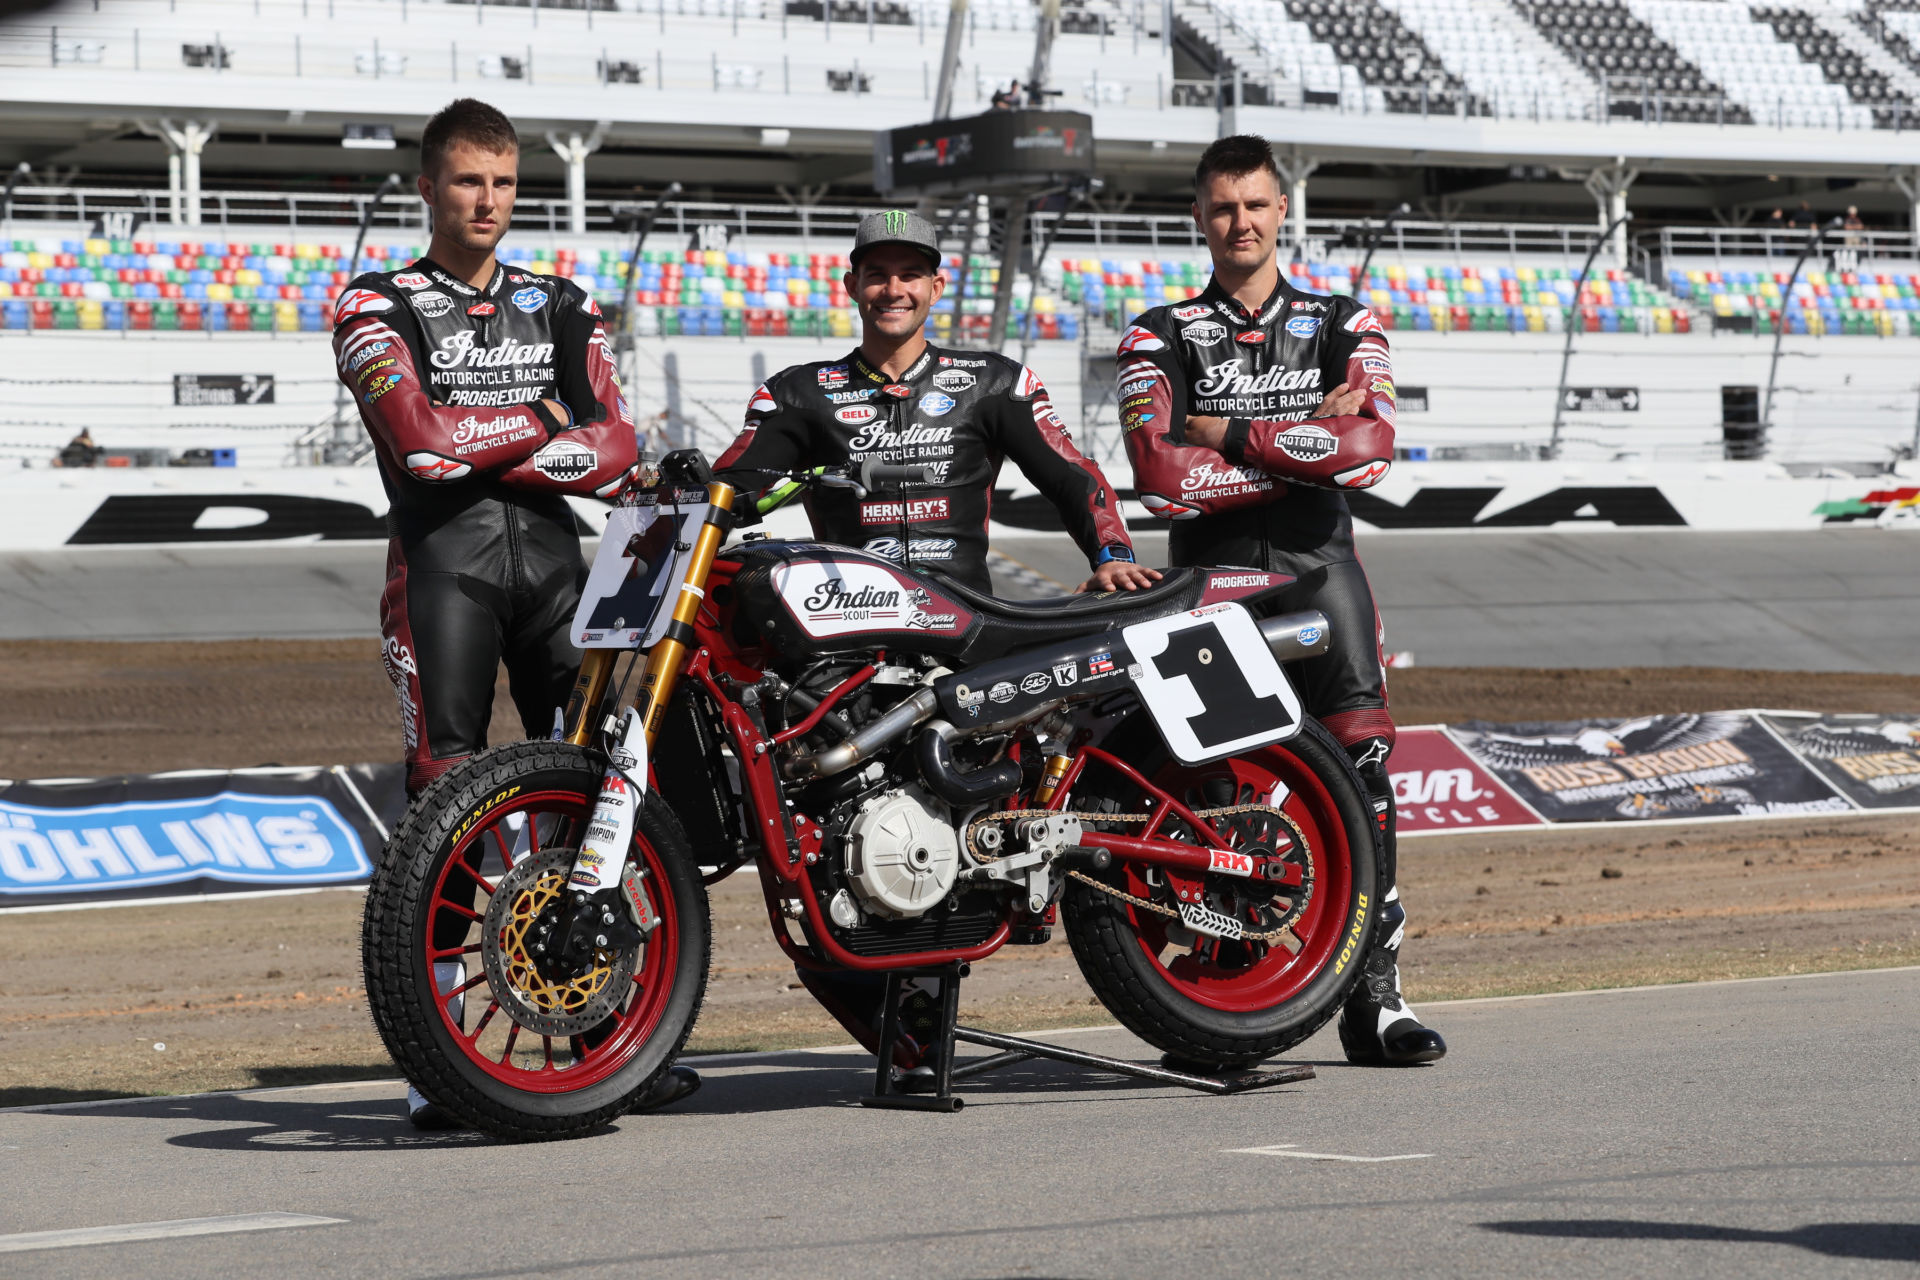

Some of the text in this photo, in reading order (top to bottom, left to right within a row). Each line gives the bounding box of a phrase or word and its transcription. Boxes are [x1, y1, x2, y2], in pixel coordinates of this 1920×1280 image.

[102, 212, 134, 239] 147
[516, 292, 546, 308] S&S
[1178, 306, 1208, 319] BELL
[1183, 328, 1225, 338] MOTOR OIL
[1291, 320, 1318, 332] S&S
[350, 341, 384, 368] DRAG
[430, 330, 555, 369] Indian
[357, 358, 396, 385] DUNLOP
[430, 367, 555, 385] MOTORCYCLE RACING
[935, 377, 960, 385] MOTOR
[1194, 359, 1321, 397] Indian
[368, 379, 396, 404] CYCLES
[446, 386, 544, 407] PROGRESSIVE
[832, 389, 869, 401] DRAG
[1196, 392, 1324, 412] MOTORCYCLE RACING
[842, 409, 871, 419] BELL
[452, 415, 530, 444] Indian
[849, 420, 953, 451] Indian
[454, 427, 537, 456] MOTORCYCLE RACING
[918, 445, 955, 457] RACING
[1278, 435, 1334, 451] MOTOR OIL
[537, 455, 594, 467] MOTOR OIL
[1180, 463, 1268, 491] Indian
[1181, 481, 1273, 501] MOTORCYCLE RACING
[862, 499, 947, 517] HERNLEY'S
[895, 512, 947, 521] MOTORCYCLE
[863, 538, 956, 559] Rogers
[585, 512, 690, 630] 1
[1210, 574, 1270, 589] PROGRESSIVE
[804, 578, 900, 612] Indian
[842, 610, 870, 621] SCOUT
[905, 610, 958, 629] Rogers
[1299, 629, 1319, 641] S&S
[1025, 676, 1047, 688] S&S
[1058, 669, 1075, 684] K
[1081, 672, 1109, 683] national
[1109, 668, 1125, 677] cycle
[1151, 621, 1295, 749] 1
[387, 635, 418, 749] Indian
[989, 689, 1008, 700] MOTOR
[1007, 686, 1017, 697] OIL
[624, 758, 638, 769] OIL
[1524, 761, 1627, 794] RUSS
[1614, 739, 1751, 780] BROWN
[1832, 751, 1920, 782] RUSS
[1553, 762, 1756, 803] MOTORCYCLE ATTORNEYS
[600, 796, 625, 807] SECO
[452, 785, 521, 847] DUNLOP
[588, 826, 617, 841] AMPION
[0, 811, 335, 883] ÖHLINS
[1213, 851, 1250, 872] RK
[626, 878, 648, 925] brembo
[1335, 892, 1369, 976] DUNLOP
